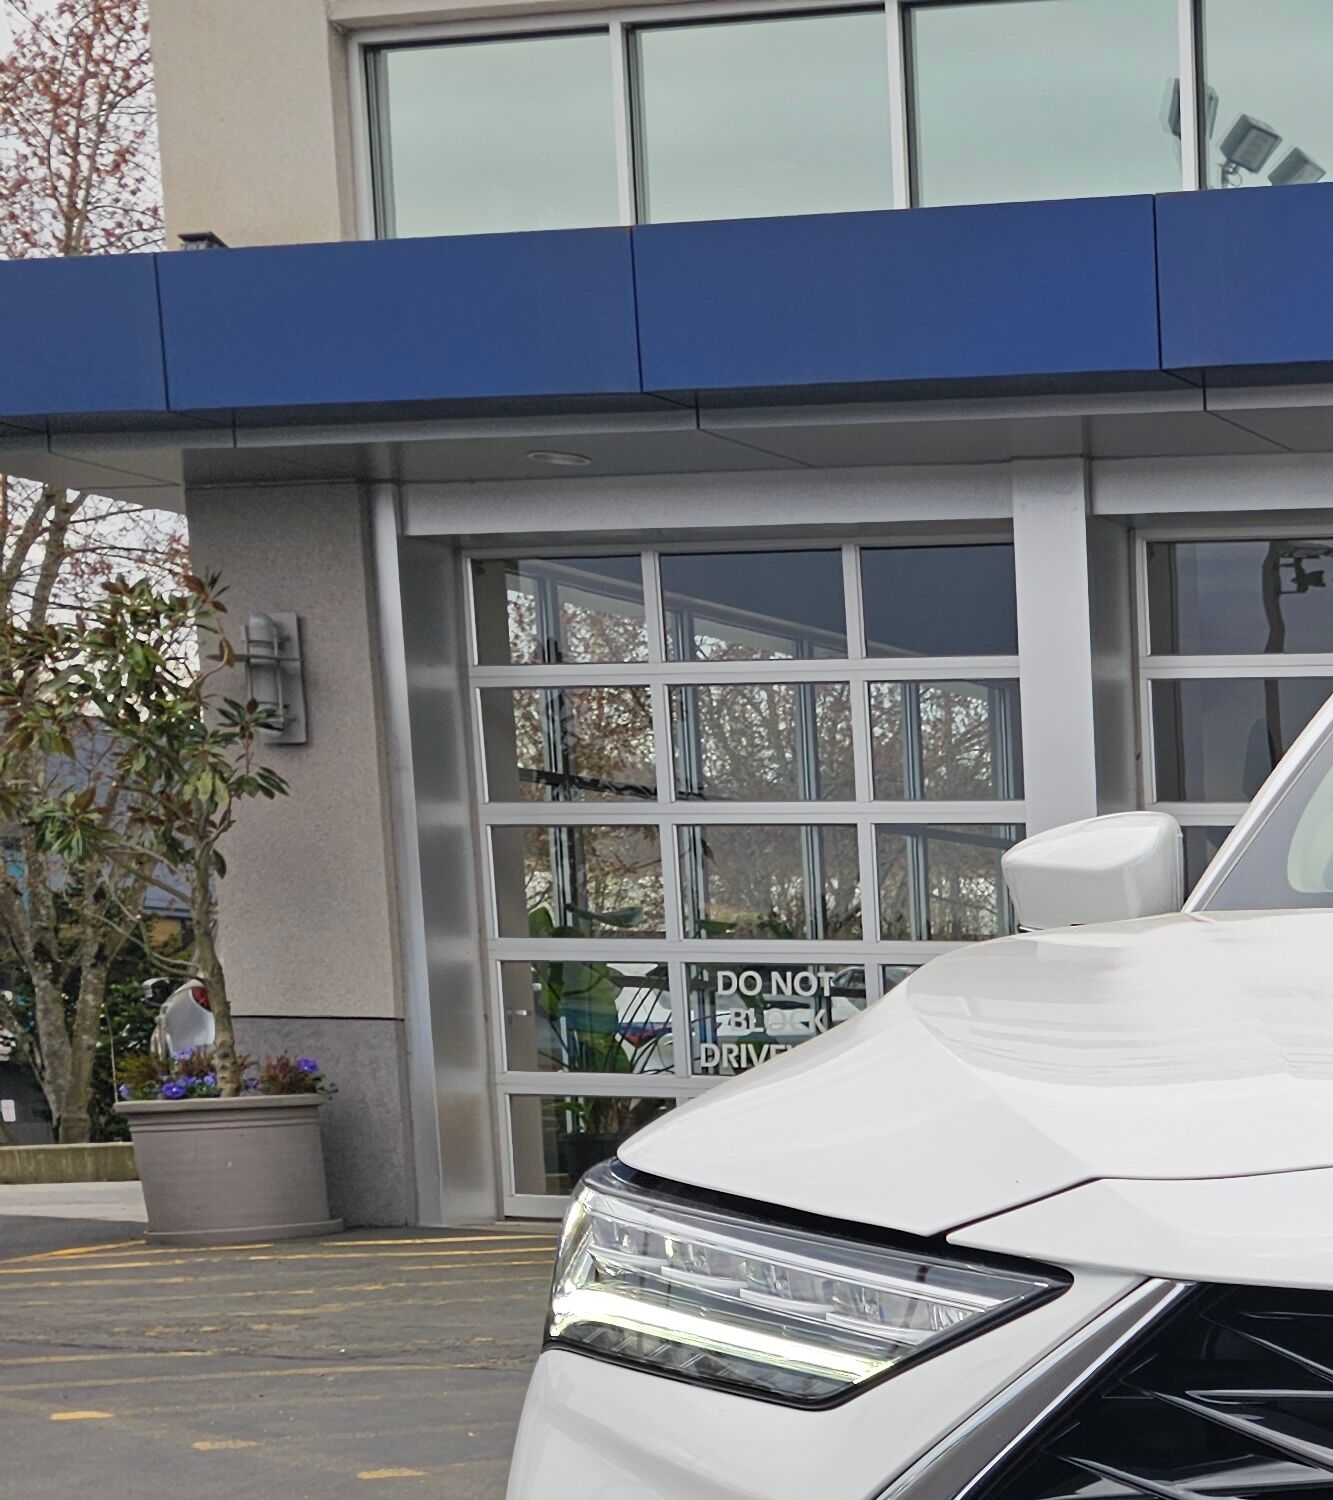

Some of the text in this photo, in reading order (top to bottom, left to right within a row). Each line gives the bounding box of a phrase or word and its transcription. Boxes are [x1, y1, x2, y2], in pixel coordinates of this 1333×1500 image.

[716, 971, 836, 997] DO NOT
[729, 1008, 826, 1034] BLOCK
[700, 1043, 793, 1068] DRIVE
